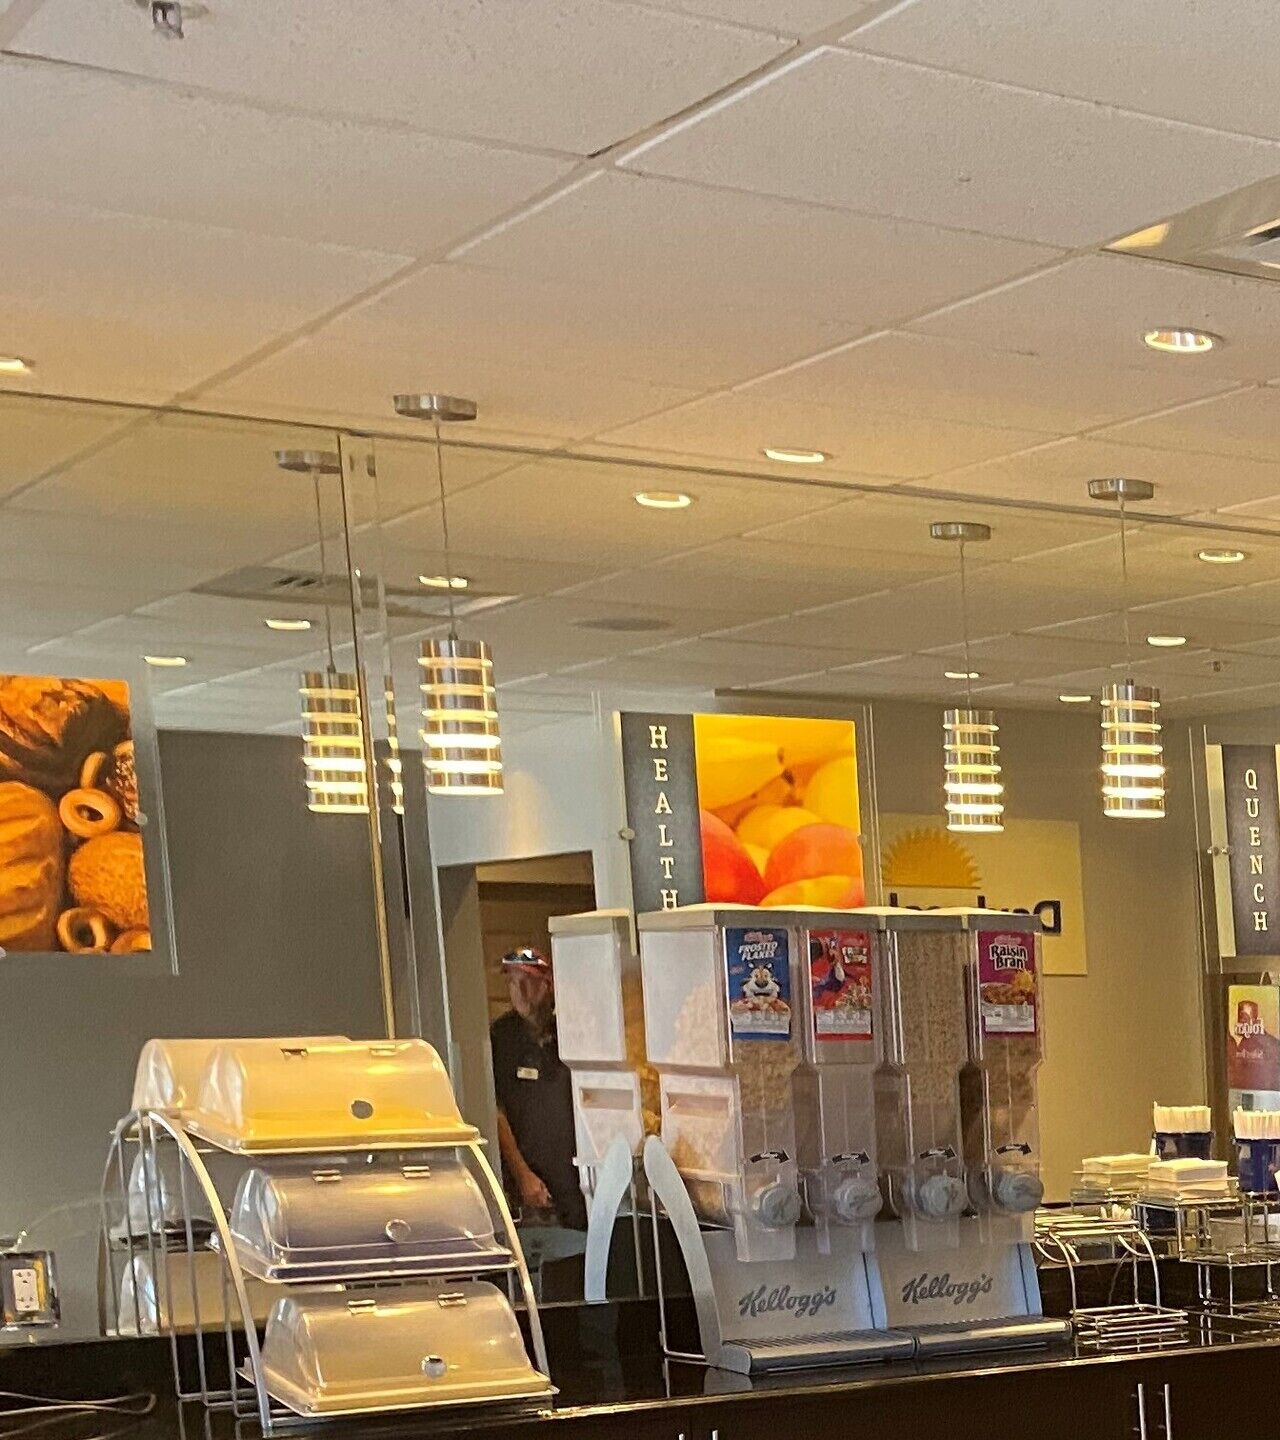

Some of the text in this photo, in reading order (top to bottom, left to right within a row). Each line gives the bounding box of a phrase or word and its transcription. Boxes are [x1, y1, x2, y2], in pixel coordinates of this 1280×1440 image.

[648, 725, 679, 911] HEALTH
[1244, 768, 1269, 932] QUENCH
[990, 944, 1027, 959] Raisin
[995, 957, 1024, 970] Bran
[738, 1284, 837, 1318] Kellogg's
[902, 1272, 994, 1305] Kellogg's
